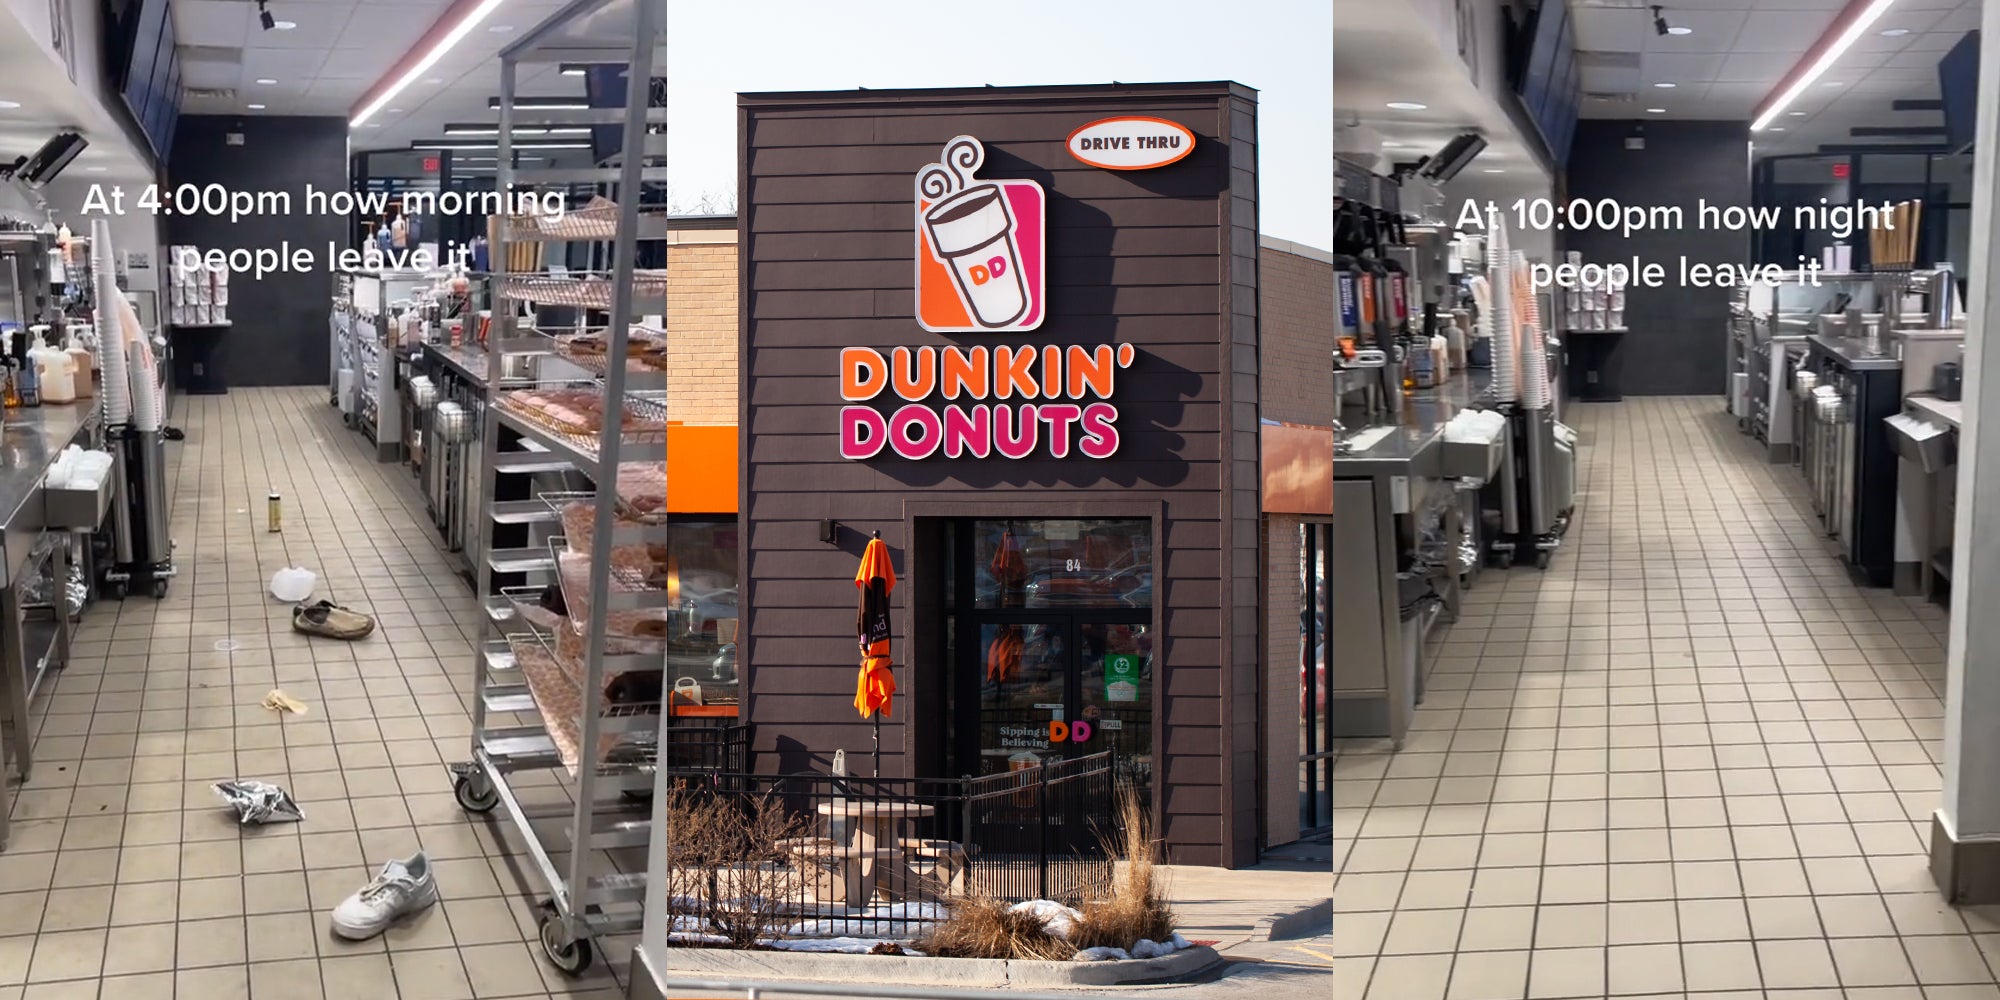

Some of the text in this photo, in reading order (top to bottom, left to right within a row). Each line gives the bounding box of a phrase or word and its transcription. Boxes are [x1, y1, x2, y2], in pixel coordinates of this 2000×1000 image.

[1081, 136, 1180, 150] DRIVE THRU
[968, 255, 1007, 286] DD
[840, 342, 1135, 402] DUNKIN'
[839, 402, 1120, 460] DONUTS
[1066, 559, 1081, 572] 84
[1106, 720, 1121, 729] PULL
[1000, 726, 1040, 738] Sipping
[1001, 737, 1050, 750] Believing
